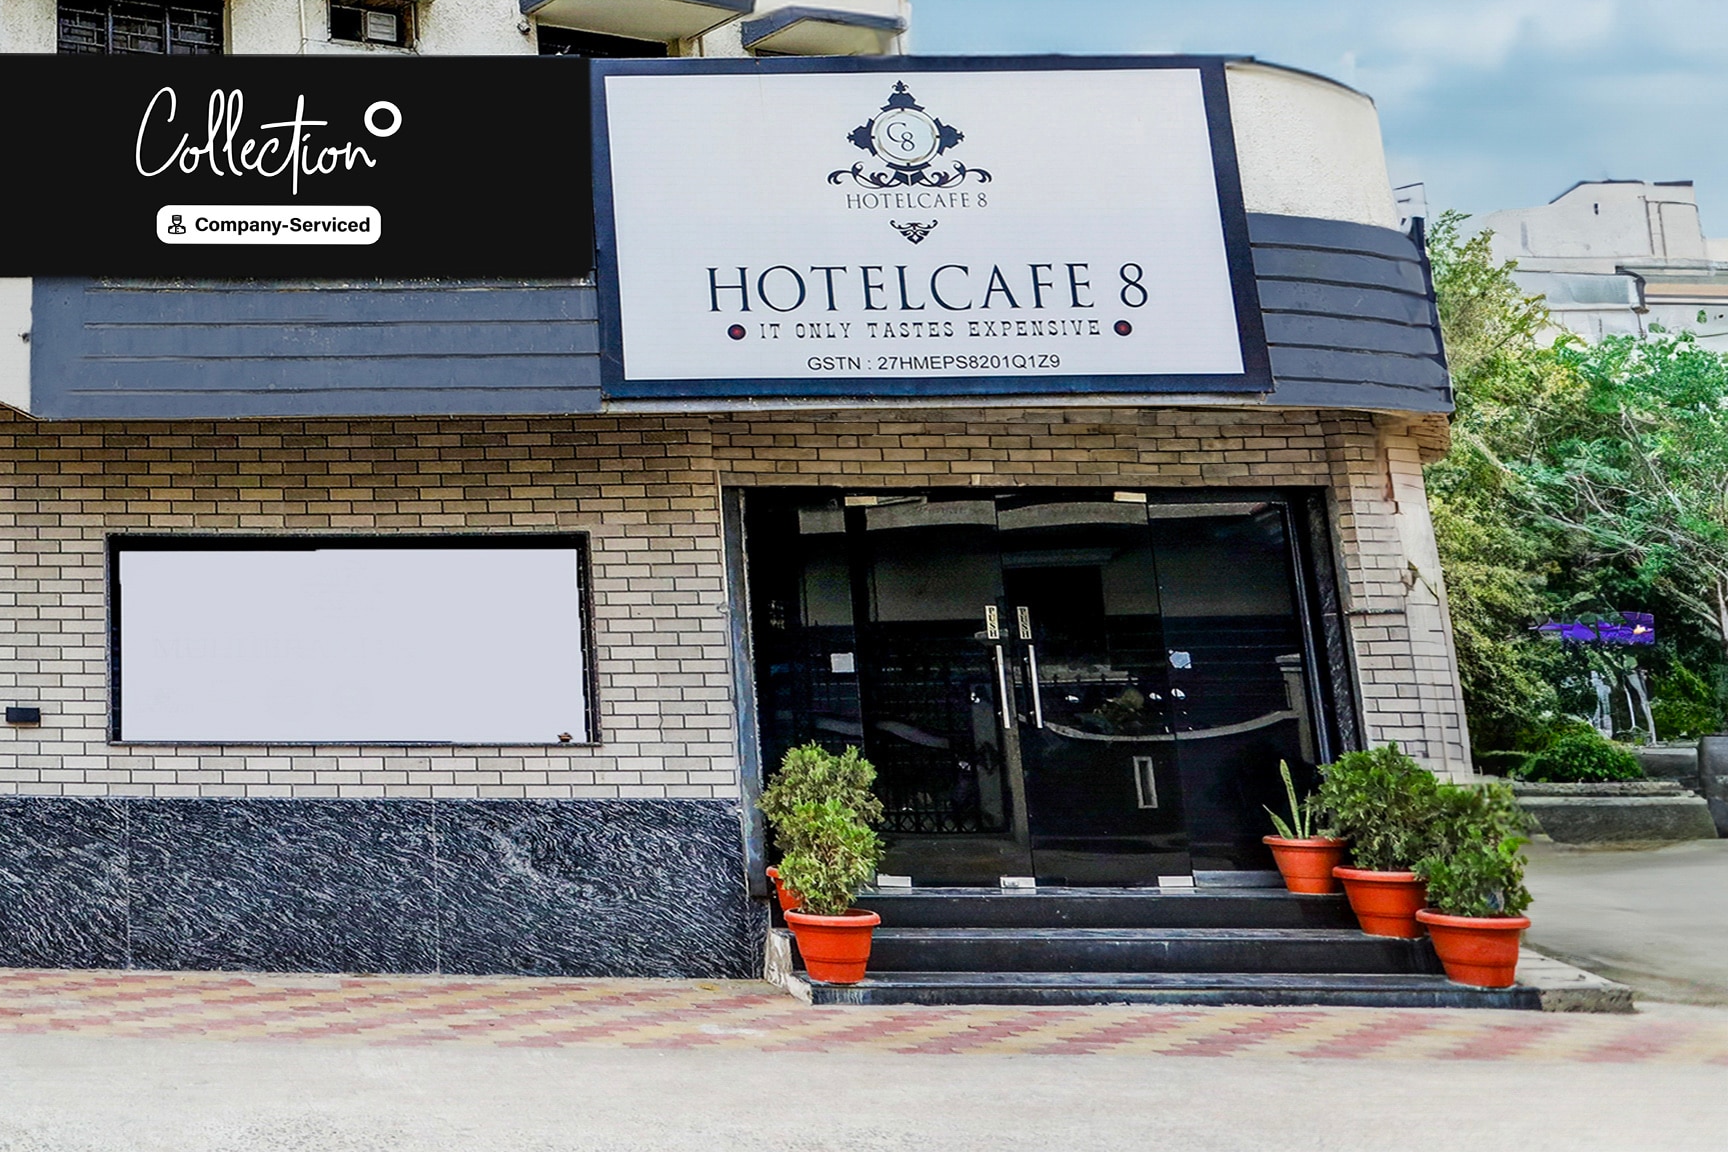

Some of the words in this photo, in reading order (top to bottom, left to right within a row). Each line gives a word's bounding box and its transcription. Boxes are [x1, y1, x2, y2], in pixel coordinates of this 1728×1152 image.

[136, 87, 377, 195] Collection
[846, 192, 970, 209] HOTELCAFE
[977, 192, 988, 208] 8
[195, 217, 370, 235] Company-Serviced
[707, 264, 1094, 312] HOTELCAFE
[1120, 263, 1148, 307] 8
[760, 324, 780, 338] IT
[796, 323, 850, 338] ONLY
[867, 322, 953, 338] TASTES
[968, 320, 1100, 336] EXPENSIVE
[808, 357, 860, 370] GSTN
[878, 355, 1060, 370] 27HMEPS8201Q1Z9
